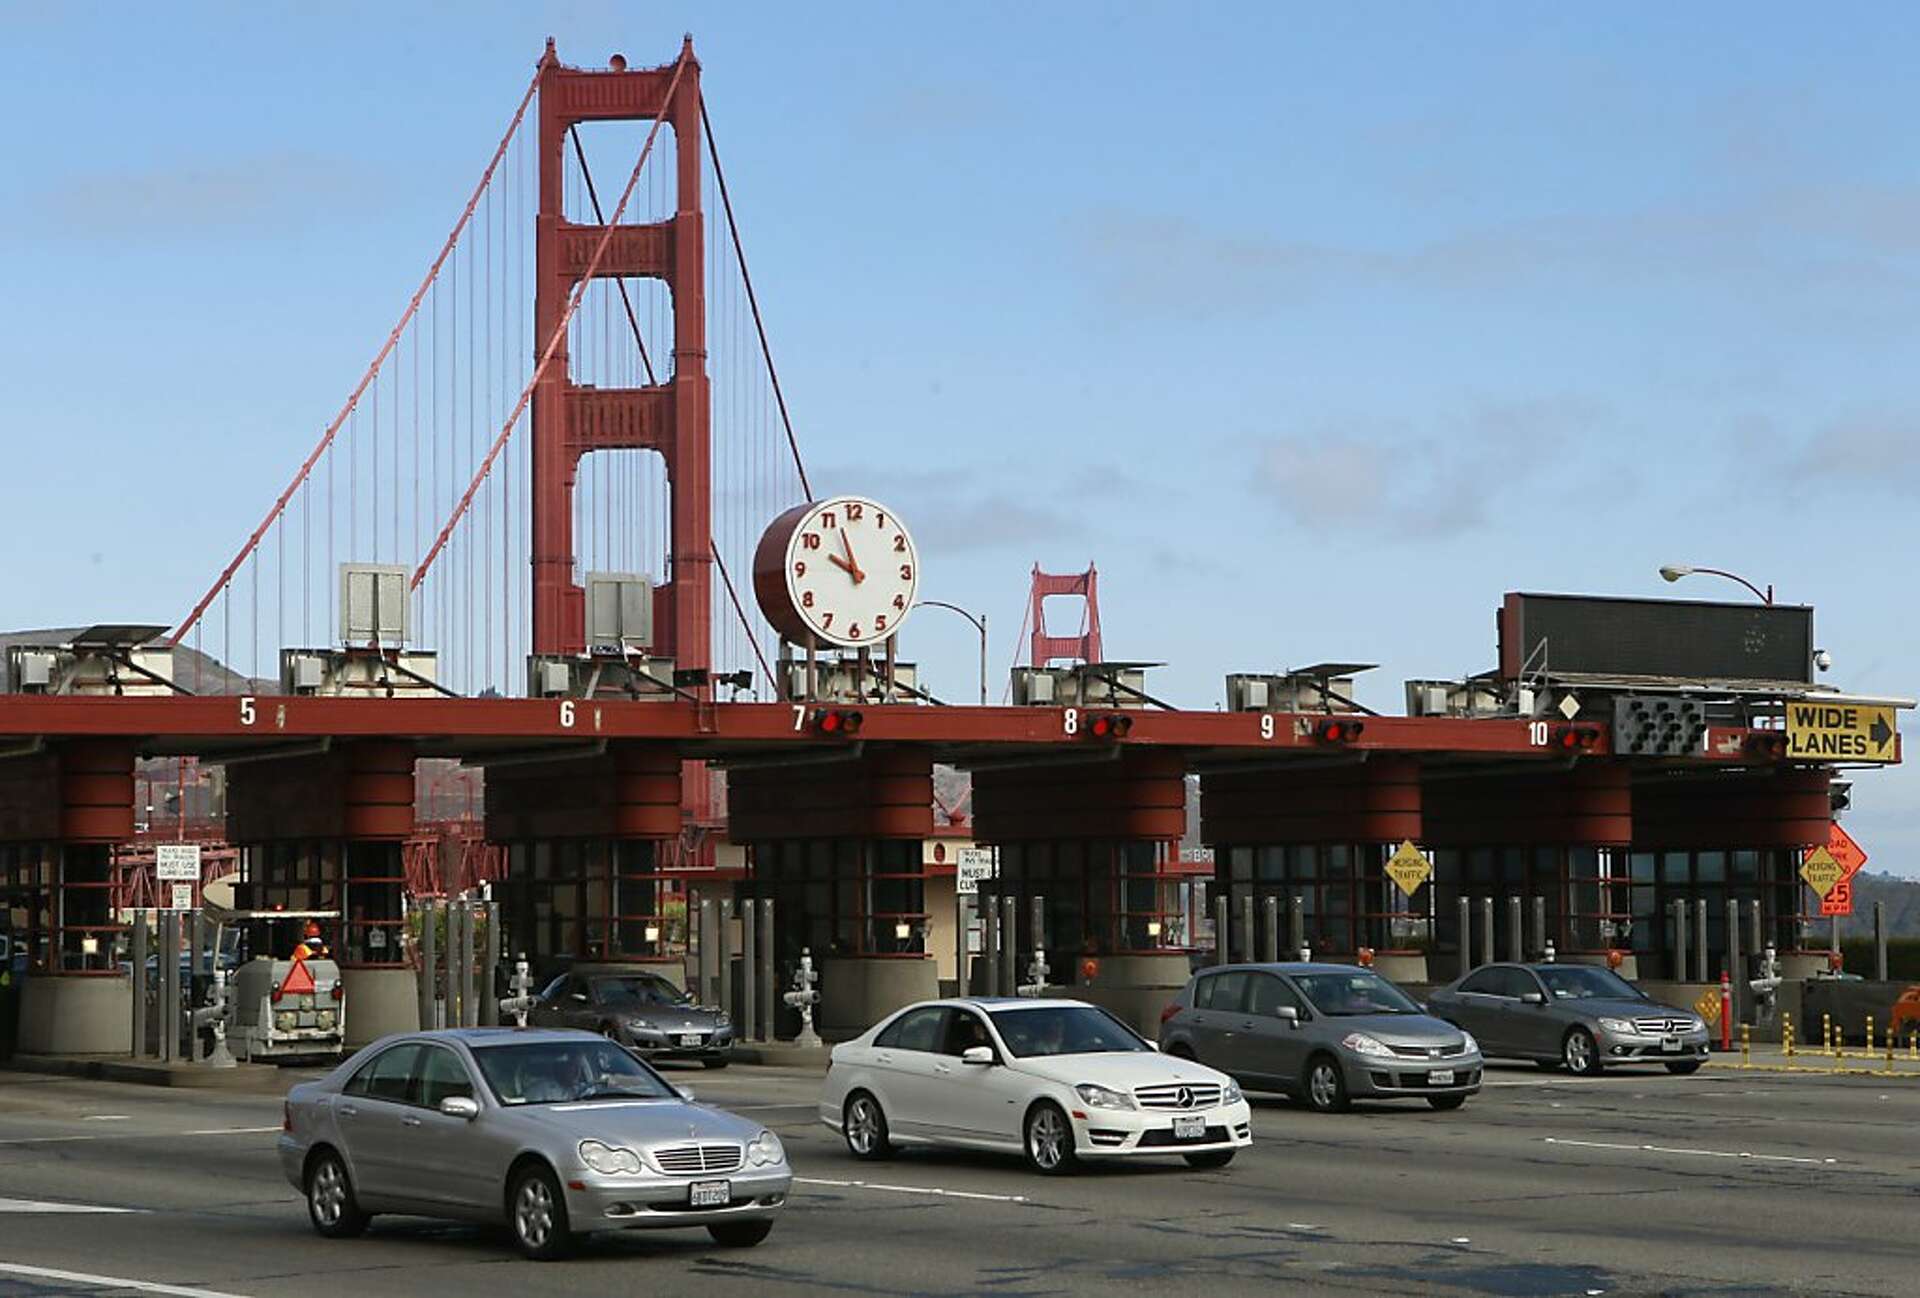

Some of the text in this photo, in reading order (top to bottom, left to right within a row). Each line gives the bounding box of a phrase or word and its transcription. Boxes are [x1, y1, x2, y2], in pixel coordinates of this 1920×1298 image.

[844, 504, 863, 520] 12
[821, 513, 836, 528] 11
[876, 514, 884, 529] 1
[802, 534, 820, 549] 10
[894, 536, 906, 552] 2
[795, 562, 805, 577] 9
[900, 565, 911, 580] 3
[803, 592, 813, 607] 8
[893, 595, 904, 609] 4
[822, 613, 833, 629] 7
[875, 615, 886, 630] 5
[849, 623, 860, 638] 6
[241, 697, 256, 725] 5
[560, 700, 575, 727] 6
[793, 705, 805, 731] 7
[1795, 707, 1857, 729] WIDE
[1064, 708, 1077, 734] 8
[1261, 714, 1274, 739] 9
[1529, 721, 1548, 746] 10
[1792, 732, 1867, 755] LANES
[1394, 859, 1423, 867] MERGING
[1808, 863, 1836, 871] MERGING
[962, 869, 984, 878] MUST
[1394, 870, 1424, 879] TRAFFIC
[1808, 874, 1836, 882] TRAFFIC
[960, 880, 977, 889] CUR
[1824, 885, 1848, 903] 25
